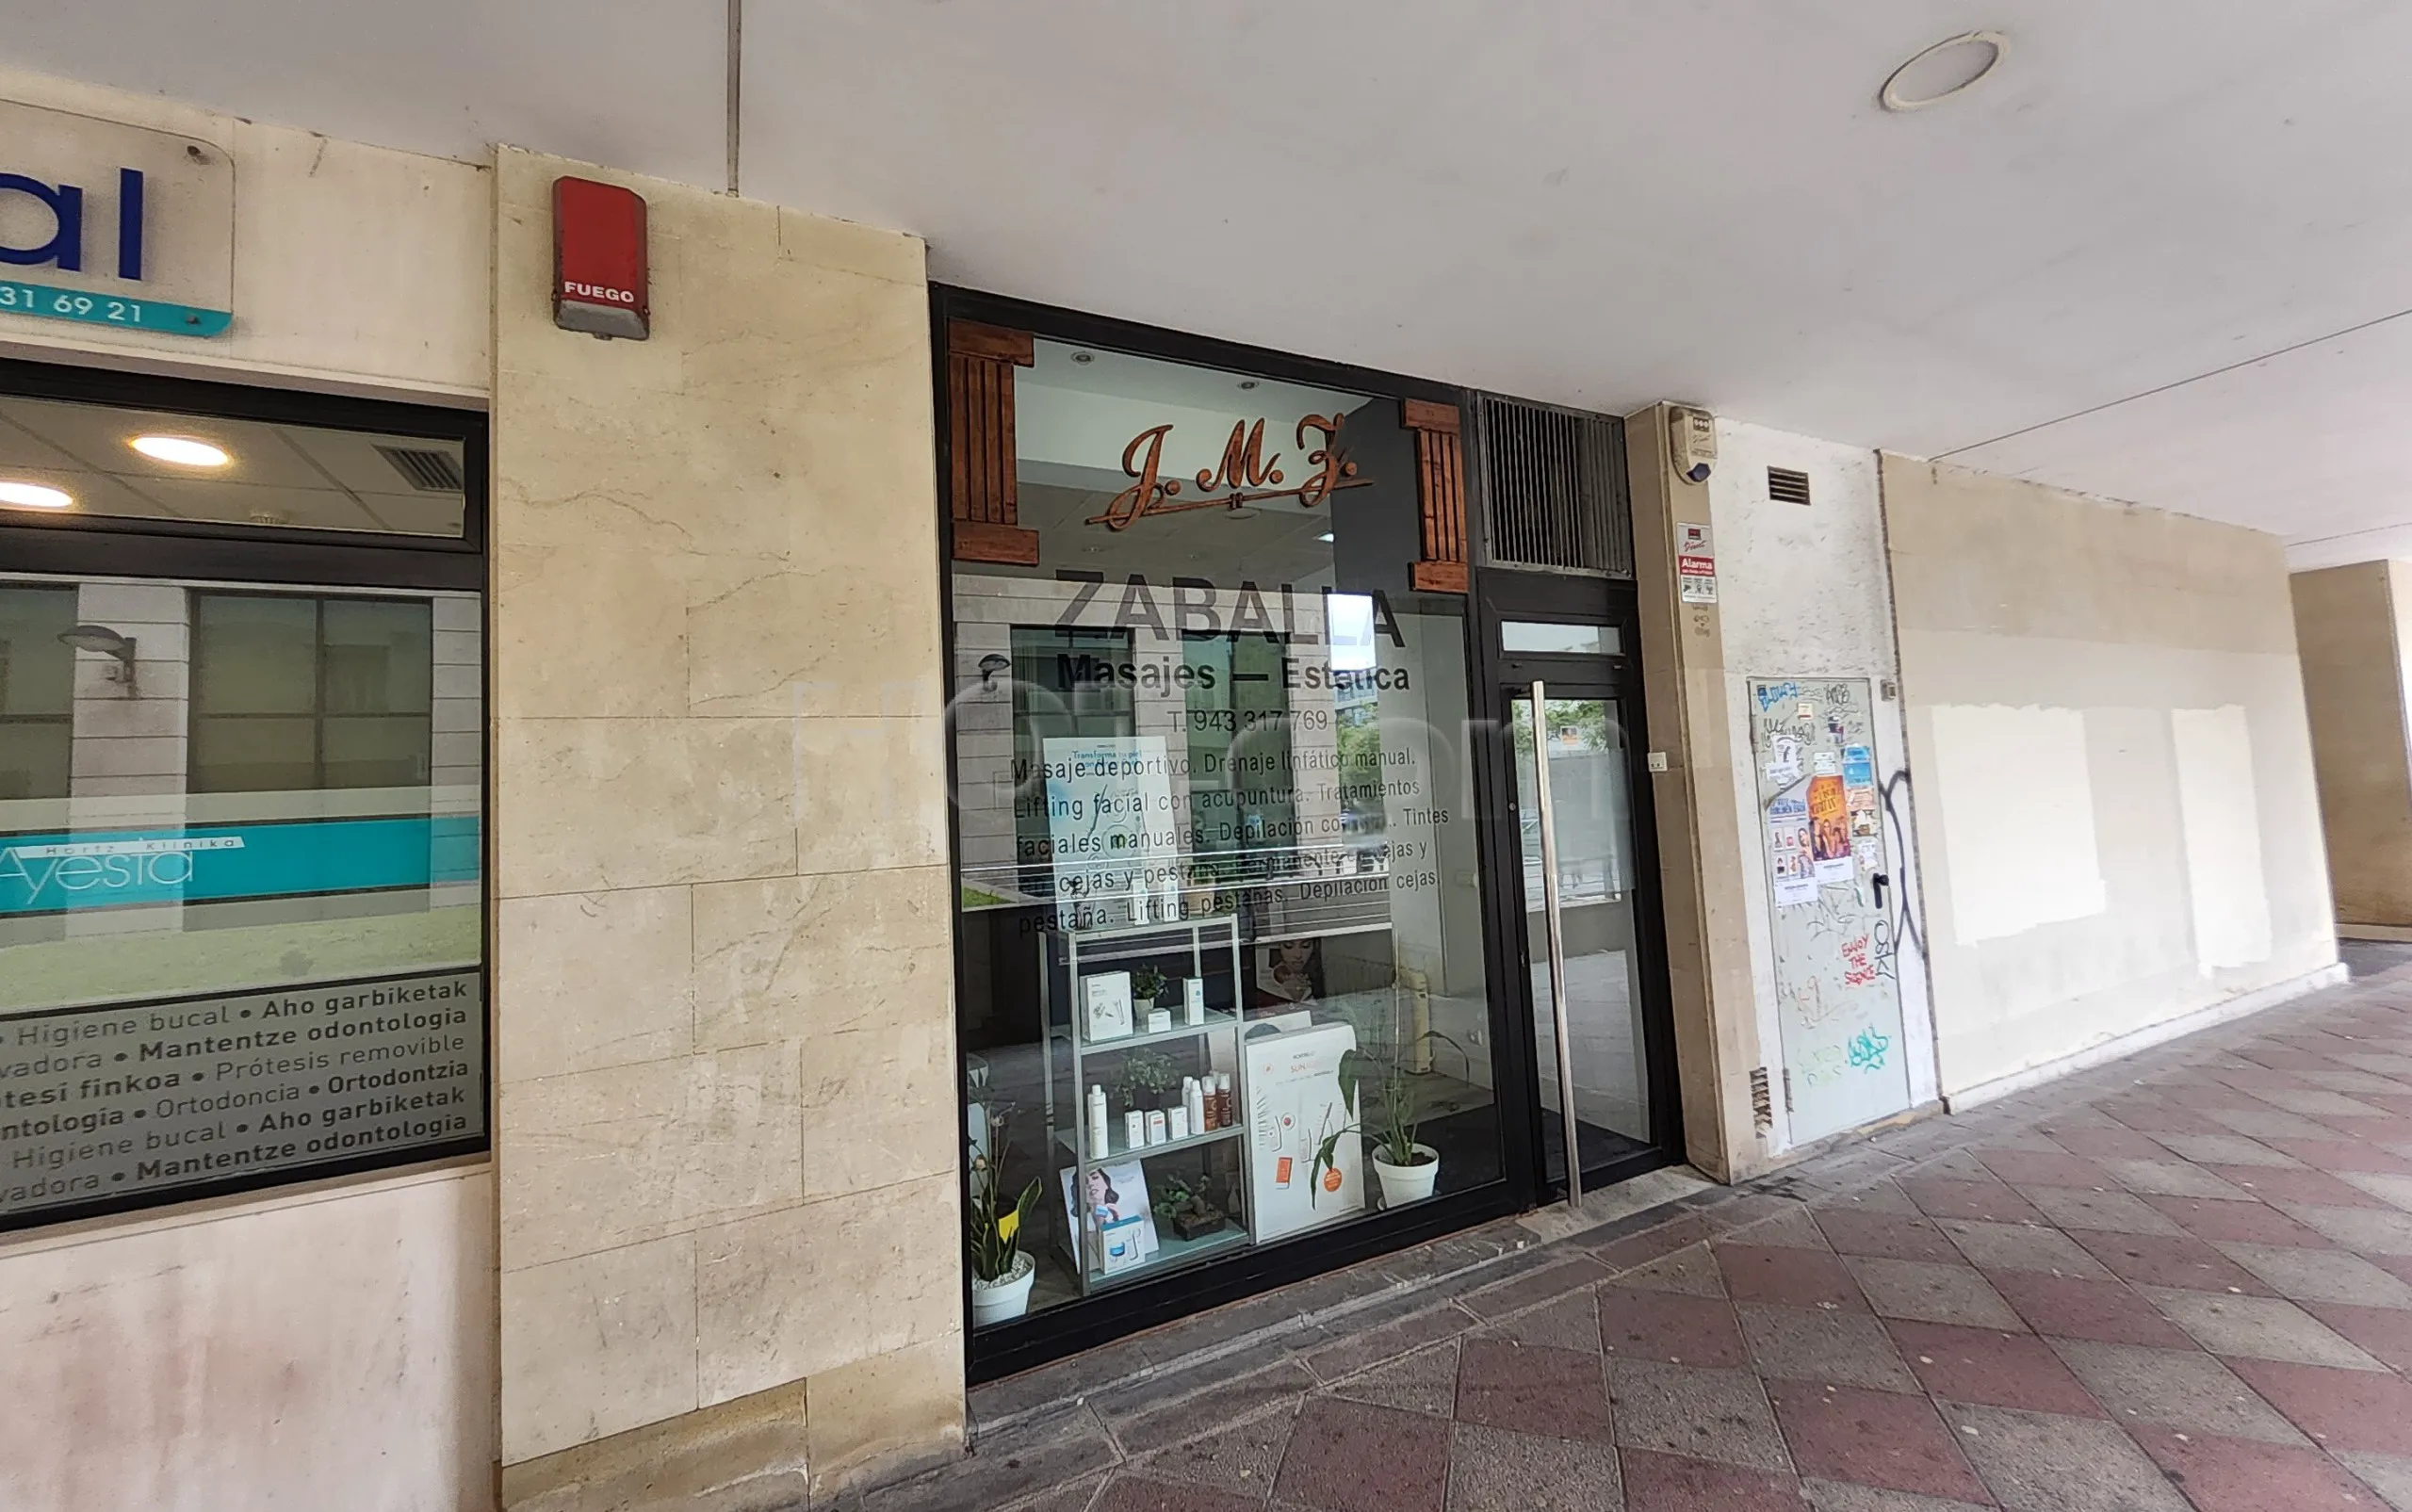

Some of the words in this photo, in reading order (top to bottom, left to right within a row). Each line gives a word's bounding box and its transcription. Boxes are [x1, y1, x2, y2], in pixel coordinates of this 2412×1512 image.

[0, 286, 35, 309] 31
[54, 294, 93, 316] 69
[107, 301, 140, 322] 21
[564, 281, 634, 303] FUEGO
[1682, 558, 1713, 570] Alarma
[1053, 568, 1407, 648] ZABALLA
[1056, 653, 1216, 698] Masajes
[1166, 710, 1187, 733] T.
[1193, 709, 1237, 733] 943
[1244, 710, 1282, 733] 317
[1290, 710, 1328, 732] 769
[1011, 756, 1087, 785] Masaje
[1094, 756, 1198, 782] deportivo.
[1204, 752, 1276, 776] Drenaje
[1281, 750, 1349, 772] linfático
[1354, 747, 1416, 770] manual.
[1071, 749, 1116, 759] Transforma
[1015, 795, 1084, 819] Lifting
[1093, 790, 1149, 813] facial
[1158, 793, 1193, 811] con
[1201, 787, 1310, 810] acupuntura.
[1317, 780, 1421, 802] Tratamientos
[45, 844, 114, 856] Hortz
[146, 838, 235, 852] Klinika
[1016, 830, 1101, 857] faciales
[1110, 826, 1211, 850] manuales.
[1219, 816, 1314, 850] Depilación
[1403, 808, 1449, 826] Tintes
[0, 846, 194, 905] Ayesta
[1059, 870, 1115, 894] cejas
[1124, 870, 1134, 891] y
[1420, 841, 1427, 859] y
[1019, 905, 1115, 937] pestaña.
[1126, 898, 1189, 922] Lifting
[18, 1019, 138, 1048] Higiene
[150, 1005, 230, 1032] bucal
[263, 999, 315, 1019] Aho
[325, 982, 467, 1016] garbiketak
[139, 1031, 297, 1063] Mantentze
[307, 1010, 466, 1042] odontologia
[0, 1082, 68, 1109] tesi
[80, 1074, 181, 1099] finkoa
[216, 1051, 330, 1081] Prótesis
[340, 1034, 465, 1065] removible
[156, 1083, 300, 1118] Ortodoncia
[328, 1060, 468, 1095] Ortodontzia
[12, 1138, 133, 1170] Higiene
[146, 1122, 227, 1150] bucal
[259, 1112, 312, 1133] Aho
[322, 1086, 465, 1127] garbiketak
[137, 1140, 297, 1181] Mantentze
[306, 1115, 466, 1153] odontologia
